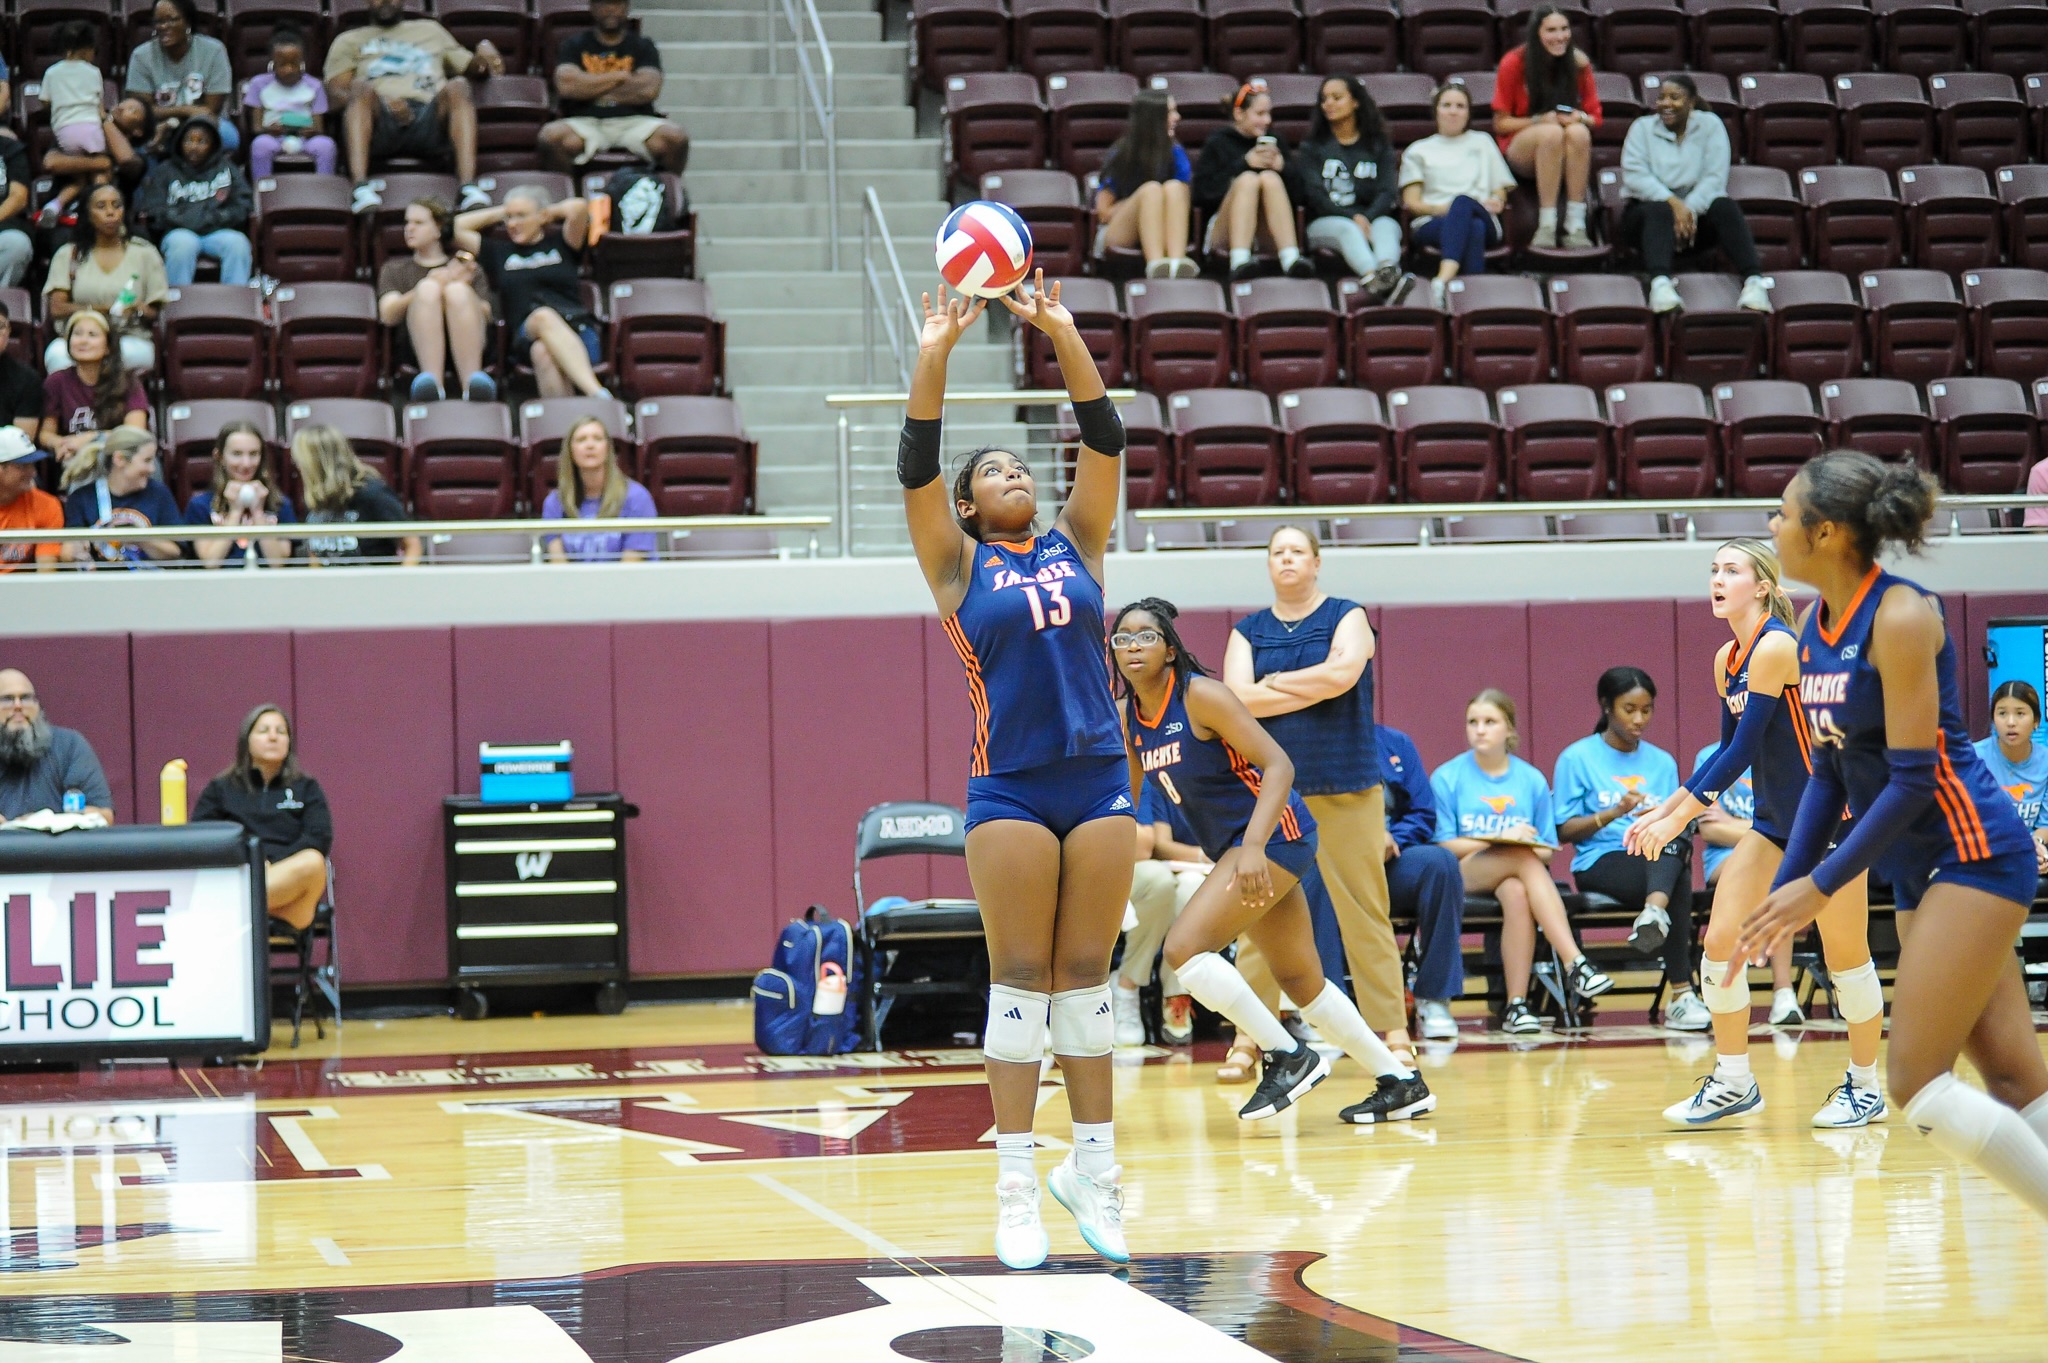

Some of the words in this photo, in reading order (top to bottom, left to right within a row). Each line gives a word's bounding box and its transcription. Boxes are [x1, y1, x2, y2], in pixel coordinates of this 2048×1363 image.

[1019, 580, 1072, 632] 13
[1460, 812, 1531, 833] SACHS
[515, 851, 553, 881] W
[4, 889, 175, 992] LIE
